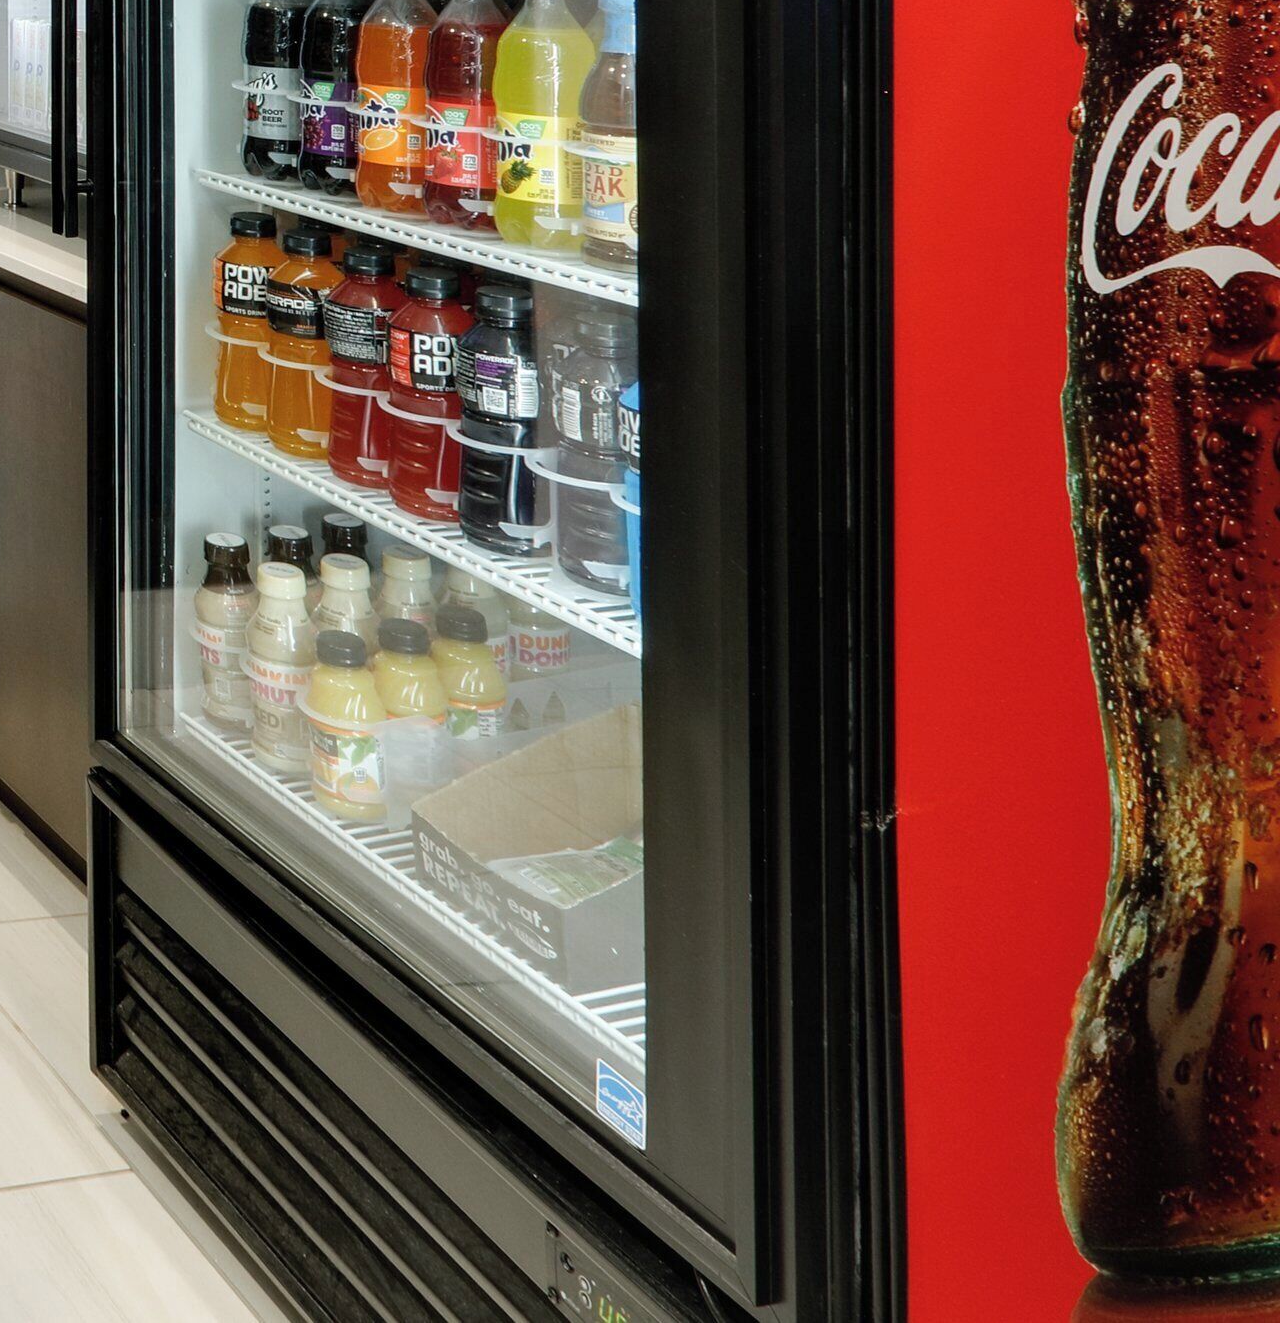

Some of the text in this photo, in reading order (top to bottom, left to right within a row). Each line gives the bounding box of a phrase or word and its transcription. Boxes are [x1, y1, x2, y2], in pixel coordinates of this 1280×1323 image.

[385, 92, 407, 101] 100%
[261, 115, 283, 123] BEER
[444, 110, 466, 118] 100%
[585, 162, 624, 177] OLD
[585, 172, 626, 198] EAK
[224, 280, 267, 302] ADE
[267, 294, 318, 310] ERADE
[225, 305, 246, 315] SPORTS
[475, 352, 517, 365] POWERADE
[416, 382, 444, 392] SPORTS
[418, 832, 465, 875] grab.
[506, 897, 550, 933] eat.
